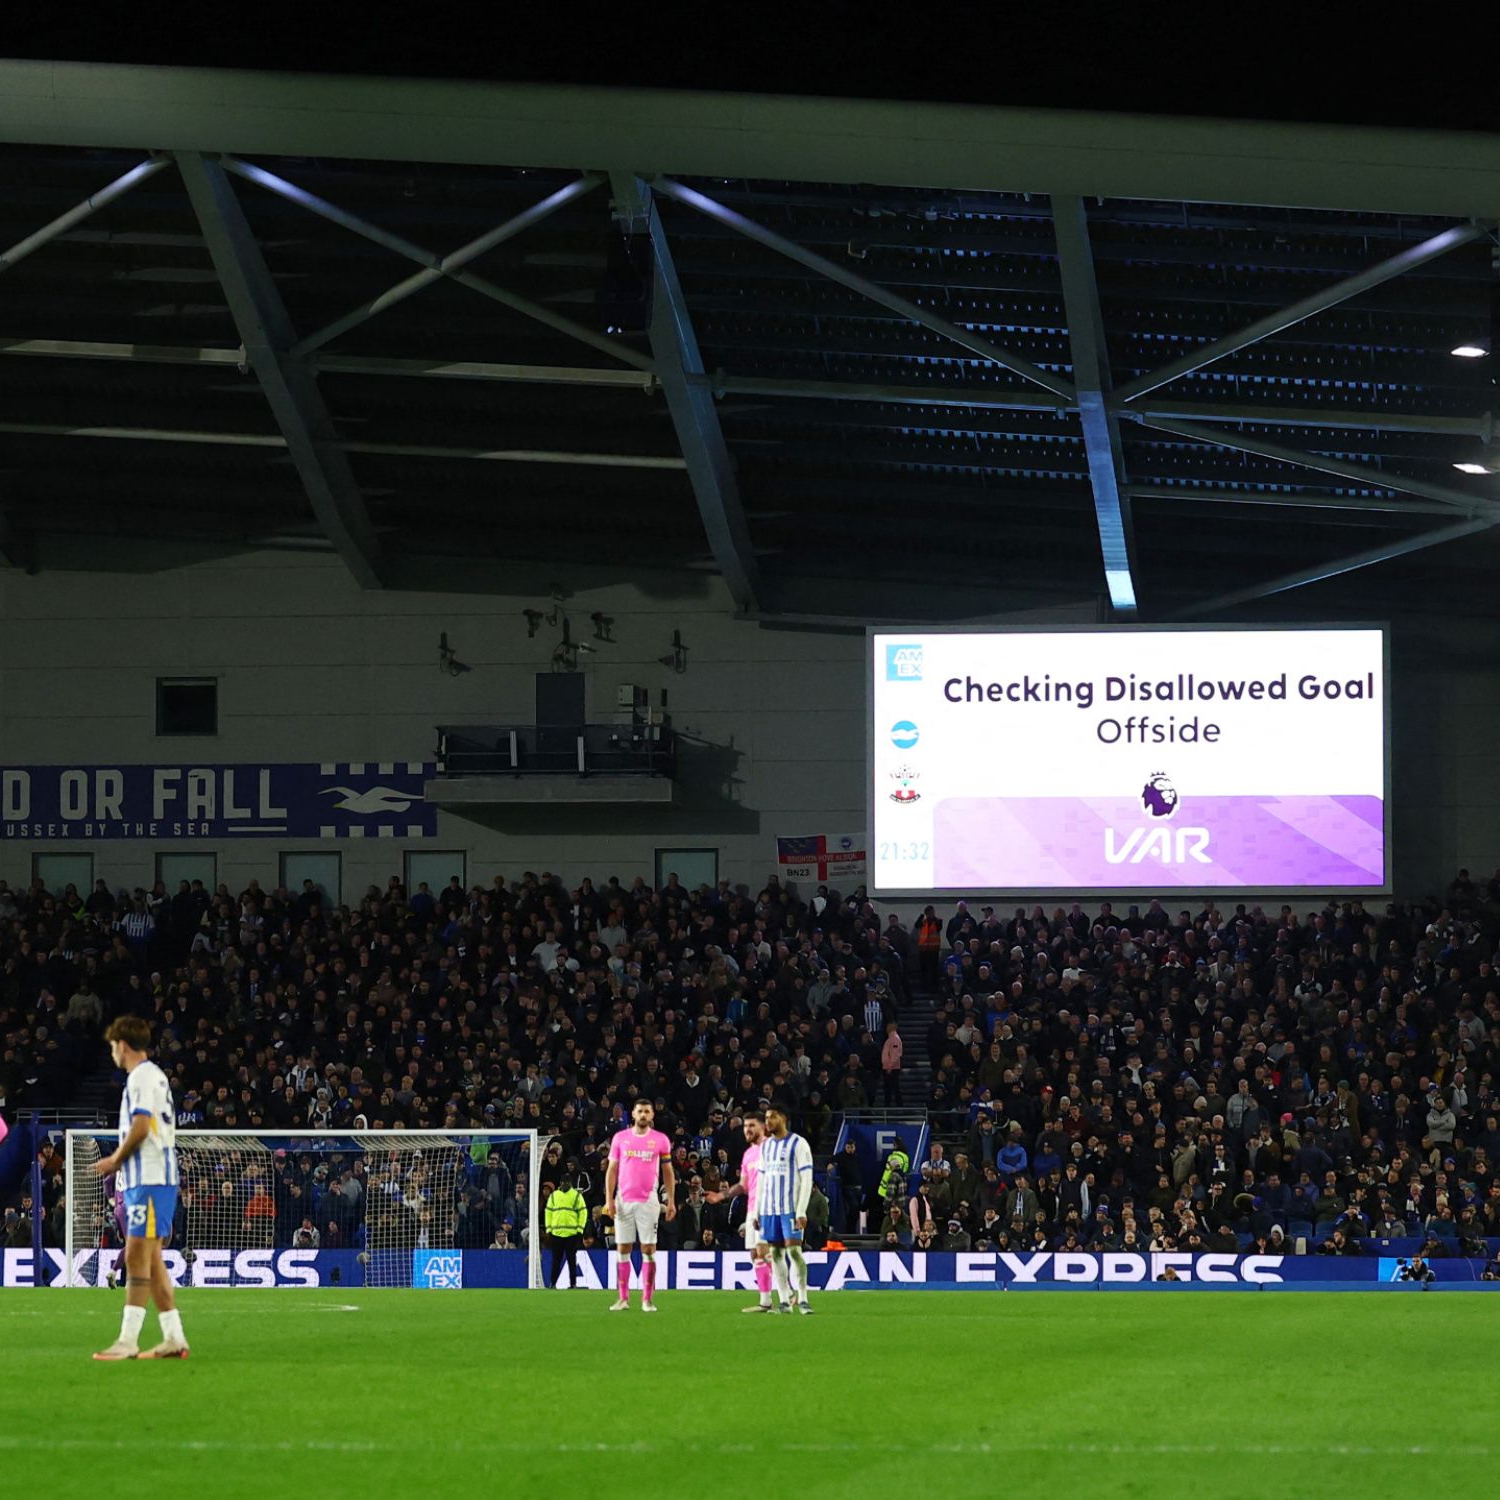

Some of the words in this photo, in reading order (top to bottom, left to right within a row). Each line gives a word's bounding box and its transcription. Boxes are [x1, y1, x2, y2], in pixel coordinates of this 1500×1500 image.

[944, 674, 1094, 709] Checking
[1106, 673, 1287, 701] Disallowed
[1298, 672, 1374, 700] Goal
[1097, 716, 1221, 744] Offside
[60, 769, 124, 820] OR
[153, 768, 288, 820] FALL
[85, 823, 106, 836] BY
[122, 822, 157, 836] THE
[174, 822, 210, 836] SEA
[880, 842, 930, 860] 21:32
[1105, 827, 1213, 864] VAR
[787, 868, 811, 877] BN23
[425, 1256, 463, 1274] AM
[429, 1274, 463, 1289] EX
